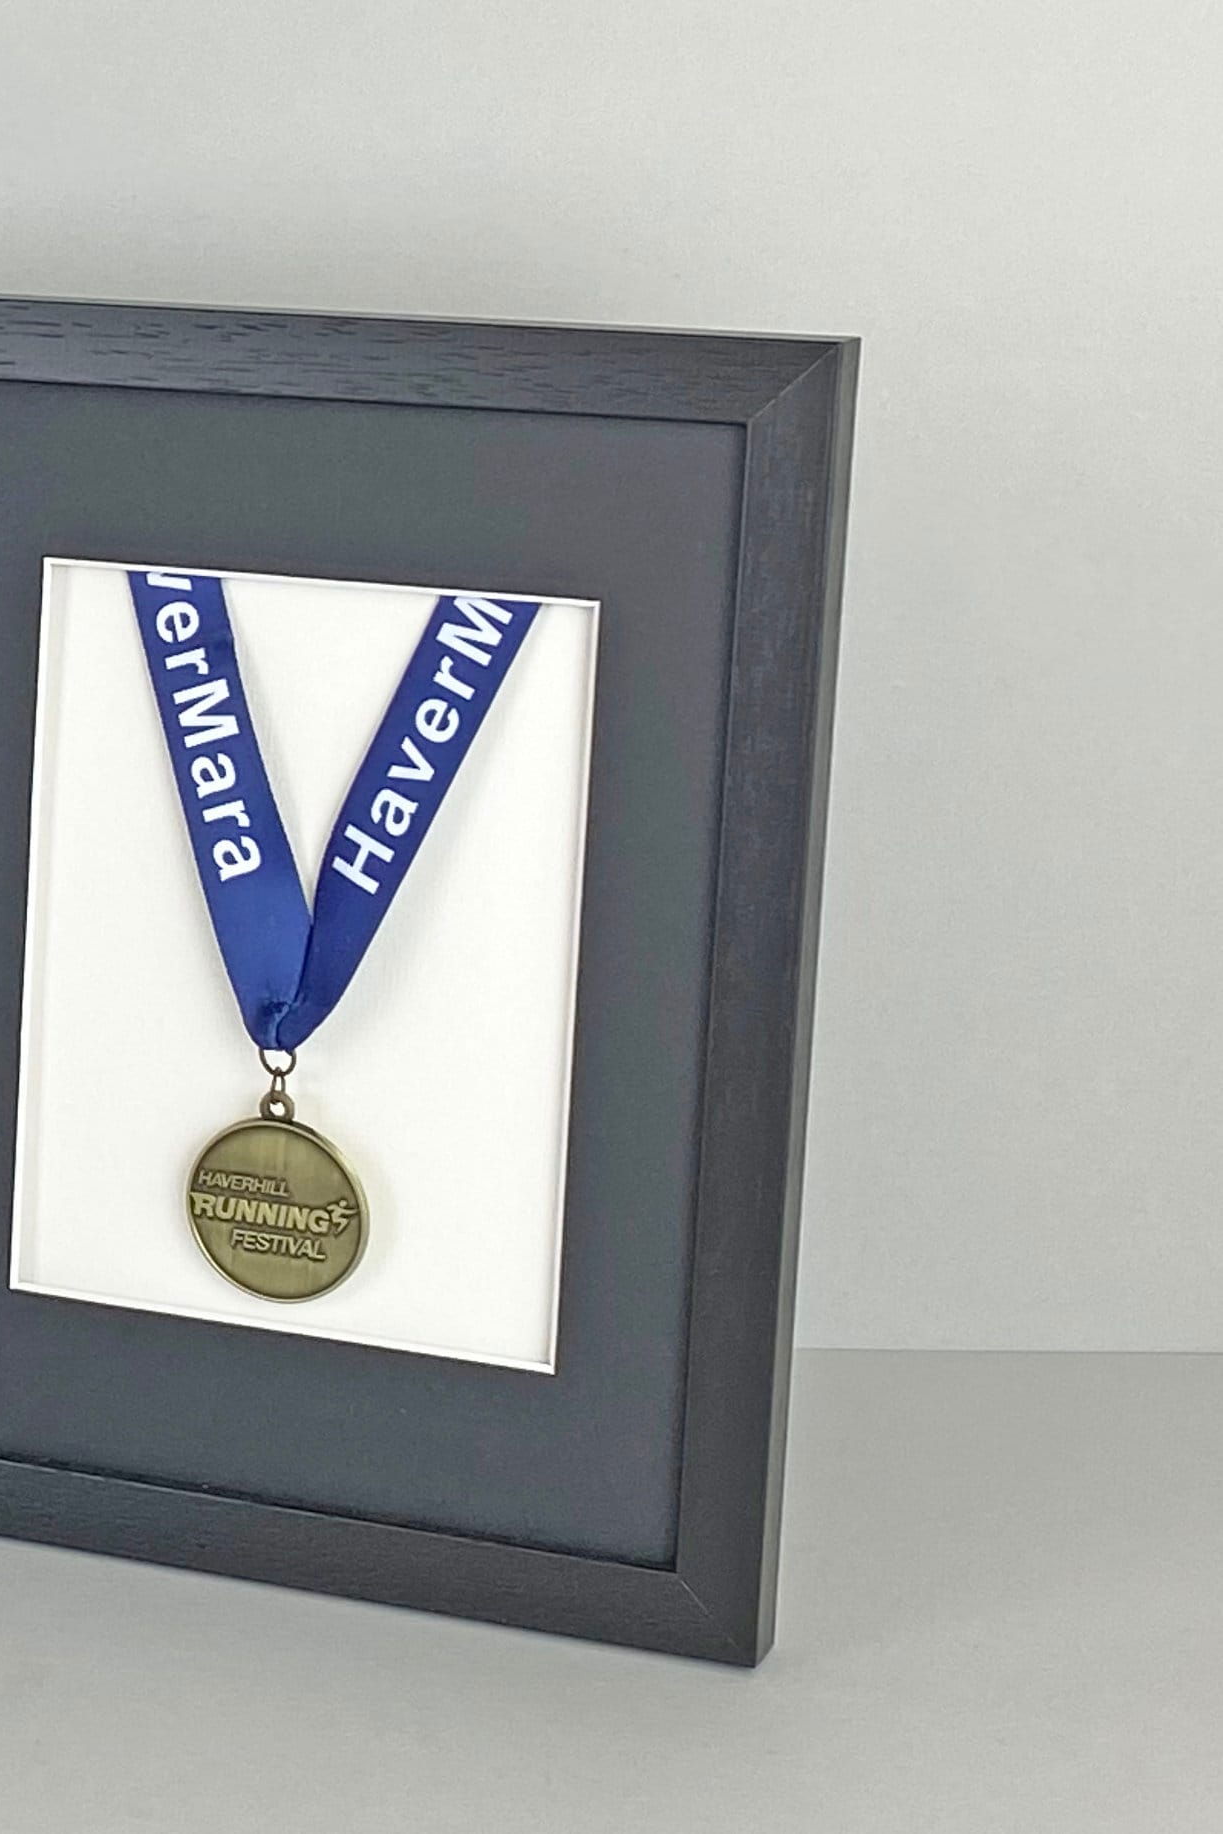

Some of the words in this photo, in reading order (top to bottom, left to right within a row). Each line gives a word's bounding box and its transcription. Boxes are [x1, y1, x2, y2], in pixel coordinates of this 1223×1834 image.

[331, 597, 513, 895] HaverM
[197, 1170, 290, 1198] HAVERHILL
[188, 1191, 330, 1235] RUNNING
[230, 1228, 327, 1262] FESTIVAL
